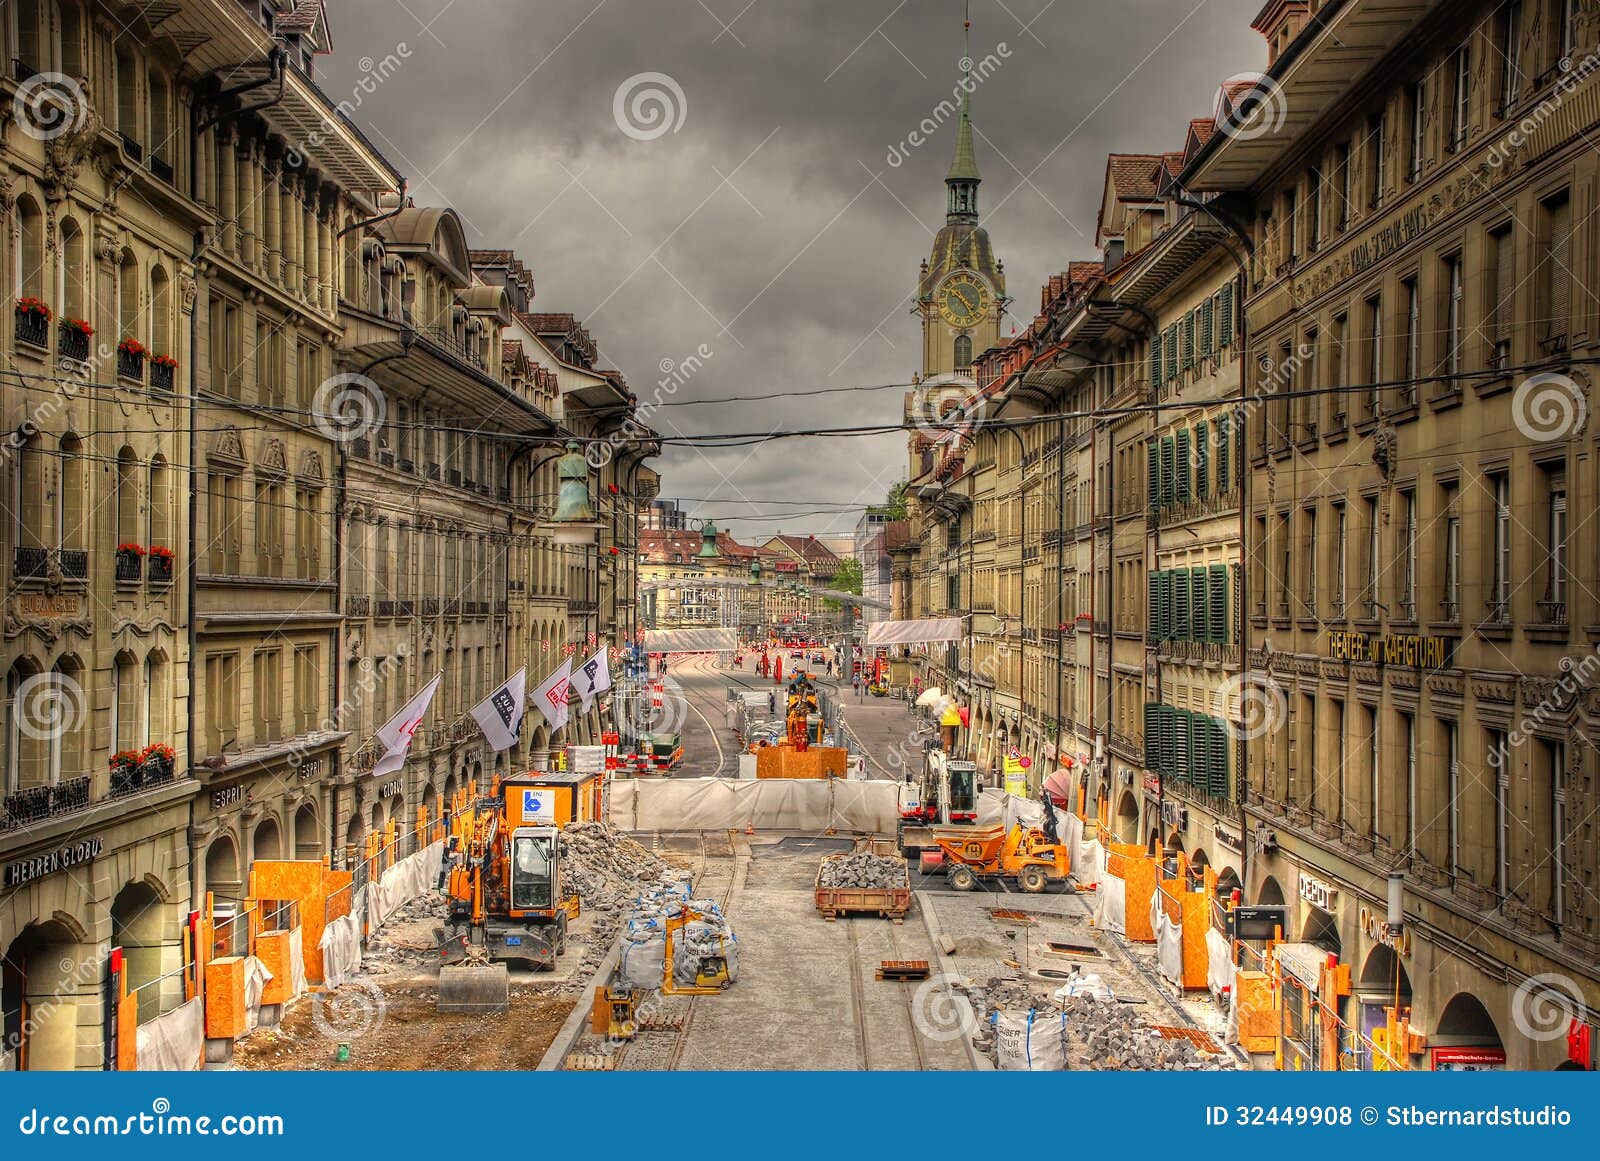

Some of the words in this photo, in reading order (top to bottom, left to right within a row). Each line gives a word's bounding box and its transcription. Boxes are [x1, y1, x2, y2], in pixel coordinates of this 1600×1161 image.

[1327, 631, 1364, 660] THEATER
[1368, 640, 1379, 661] AM
[216, 785, 244, 808] ESPRIT
[383, 779, 403, 798] GLOBUS
[12, 853, 58, 885] HERREN
[62, 838, 104, 867] GLOBUS
[1299, 873, 1338, 913] DEPOT
